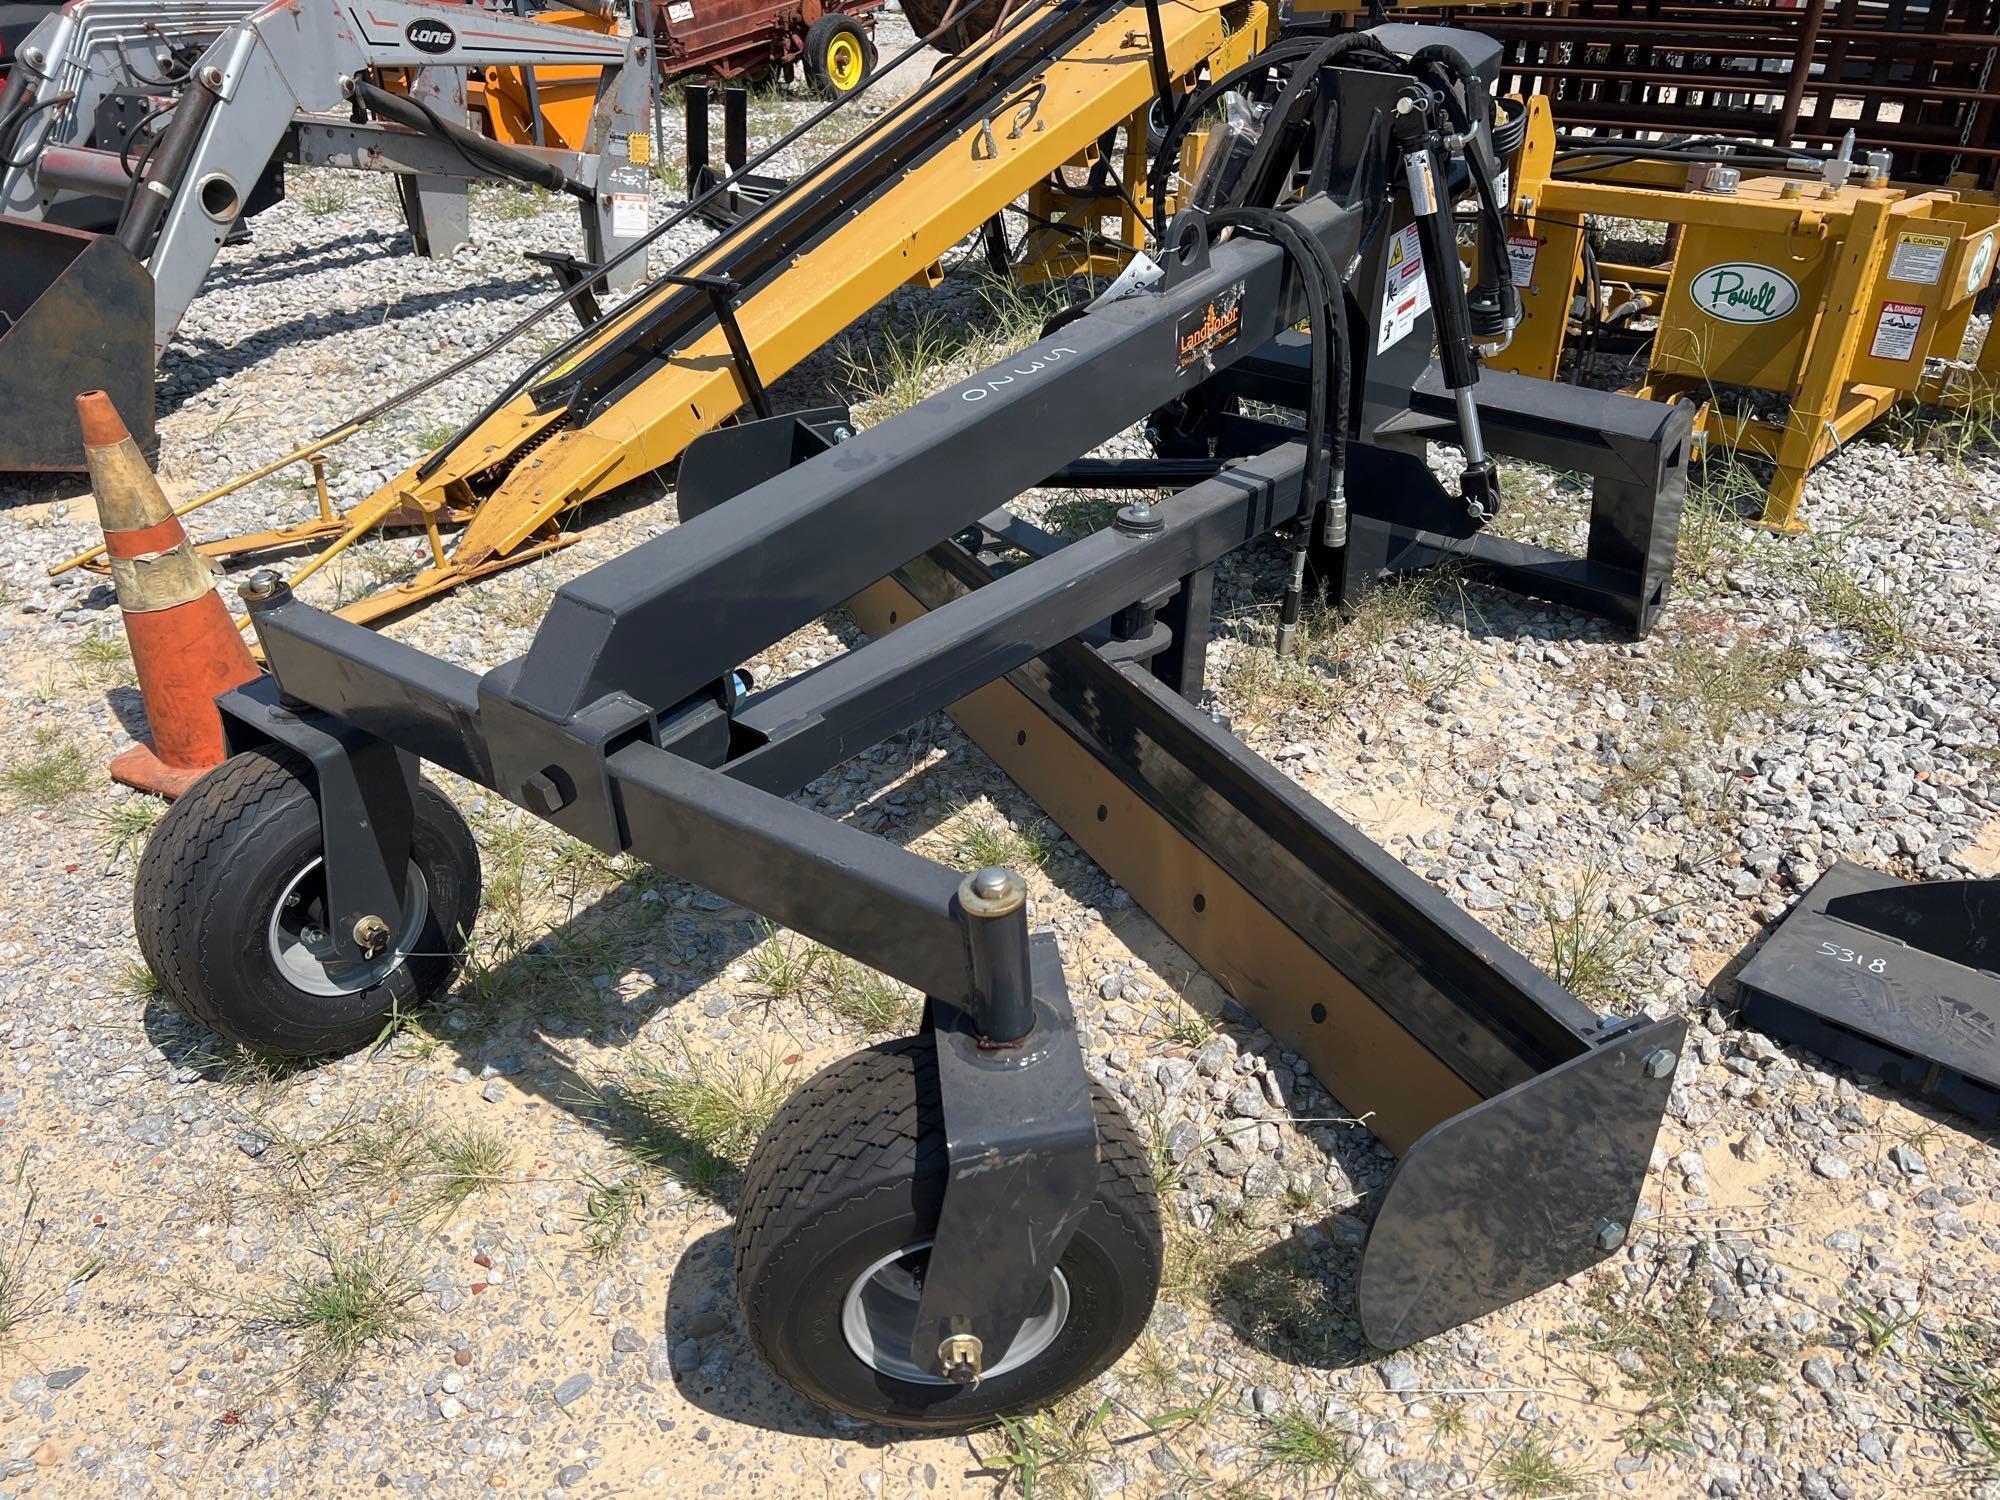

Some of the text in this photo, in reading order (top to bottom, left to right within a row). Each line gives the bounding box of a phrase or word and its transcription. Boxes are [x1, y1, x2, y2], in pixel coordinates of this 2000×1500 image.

[410, 28, 452, 45] LONG
[1515, 238, 1538, 248] DANGER
[1913, 237, 1945, 247] CAUTION
[1710, 270, 1776, 317] Powell
[1894, 304, 1923, 316] DANGER
[1181, 305, 1239, 353] LandHonor
[962, 347, 1077, 401] 5320
[1815, 942, 1887, 973] 5318
